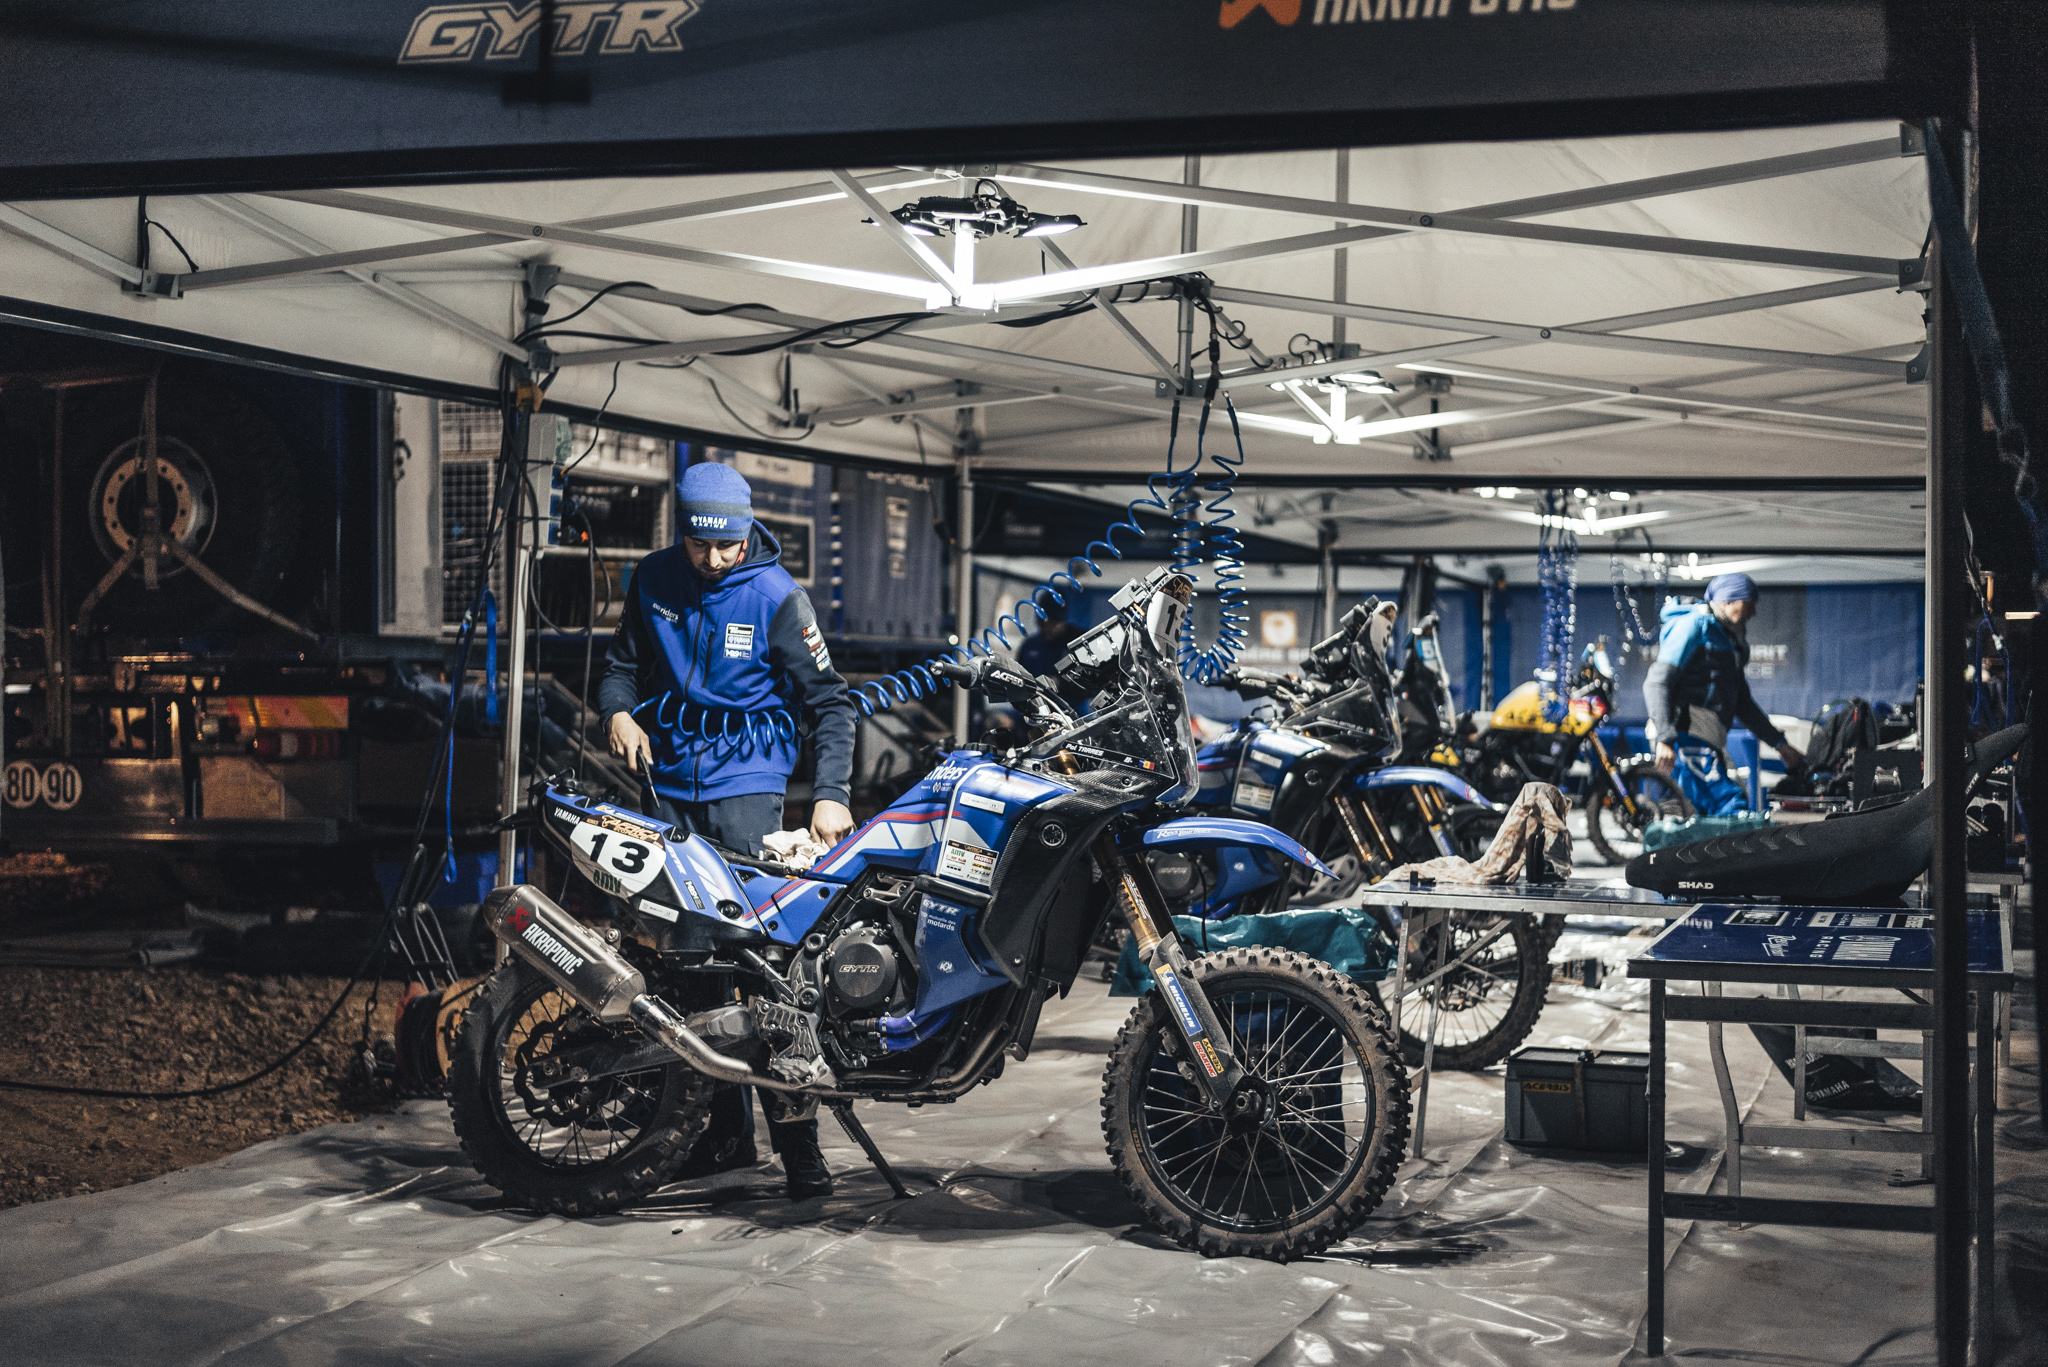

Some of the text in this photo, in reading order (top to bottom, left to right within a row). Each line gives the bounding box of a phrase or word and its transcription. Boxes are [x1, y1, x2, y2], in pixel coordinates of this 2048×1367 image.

[398, 0, 700, 64] GYTR
[698, 515, 728, 526] YAMAHA
[1065, 743, 1078, 751] Pol
[7, 767, 76, 805] 80 90
[553, 807, 580, 825] YAMAHA
[591, 833, 650, 874] 13
[1678, 881, 1714, 890] SHAD
[923, 899, 961, 916] GYTR
[927, 919, 956, 931] motards
[521, 922, 584, 976] AKRAPOVIČ
[1809, 935, 1834, 958] RACING
[838, 964, 880, 973] GYTR
[1169, 985, 1196, 1028] MICHELIN
[1194, 1041, 1217, 1078] BRAKING
[1815, 1080, 1850, 1098] YAMAHA
